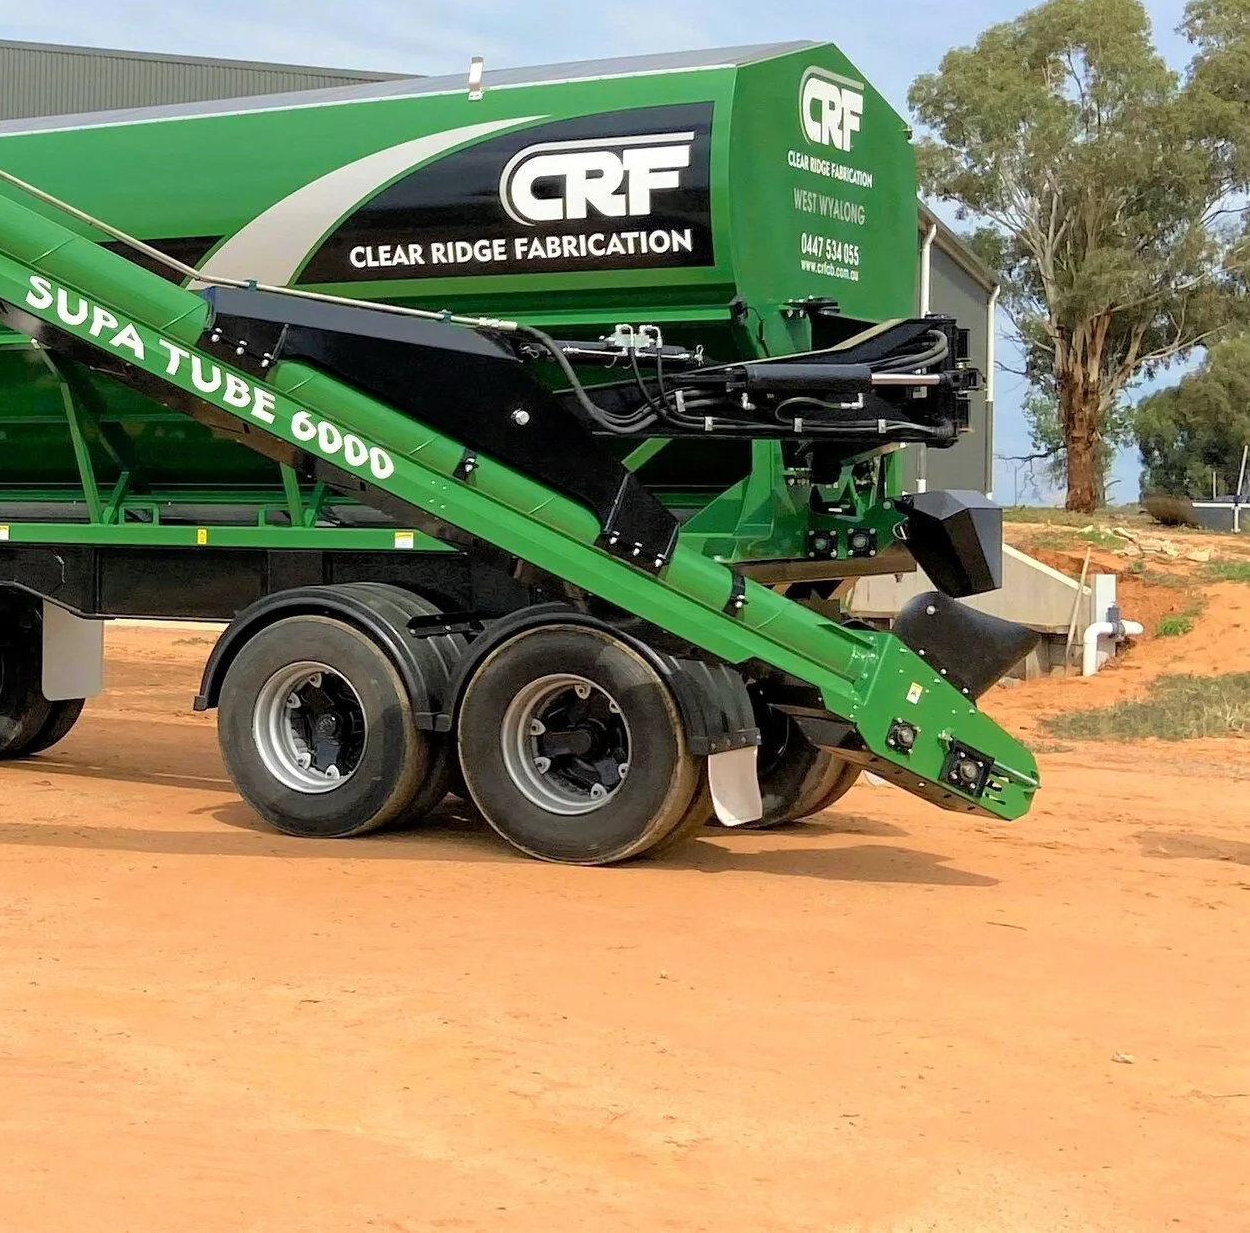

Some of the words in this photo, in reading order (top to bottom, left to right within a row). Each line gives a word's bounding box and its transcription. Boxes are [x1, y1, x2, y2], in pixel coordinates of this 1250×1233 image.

[802, 77, 864, 153] CRF
[510, 144, 690, 222] CRF
[787, 150, 810, 171] CLEAR
[810, 156, 831, 177] RIDGE
[831, 162, 873, 188] FABRICATION
[793, 187, 818, 214] WEST
[818, 194, 866, 225] WYALONG
[350, 243, 425, 268] CLEAR
[431, 238, 508, 265] RIDGE
[515, 229, 693, 261] FABRICATION
[801, 232, 824, 258] 0447
[825, 238, 843, 263] 534
[843, 242, 860, 266] 055
[25, 274, 145, 361] SUPA
[158, 338, 277, 425] TUBE
[290, 409, 395, 480] 6000
